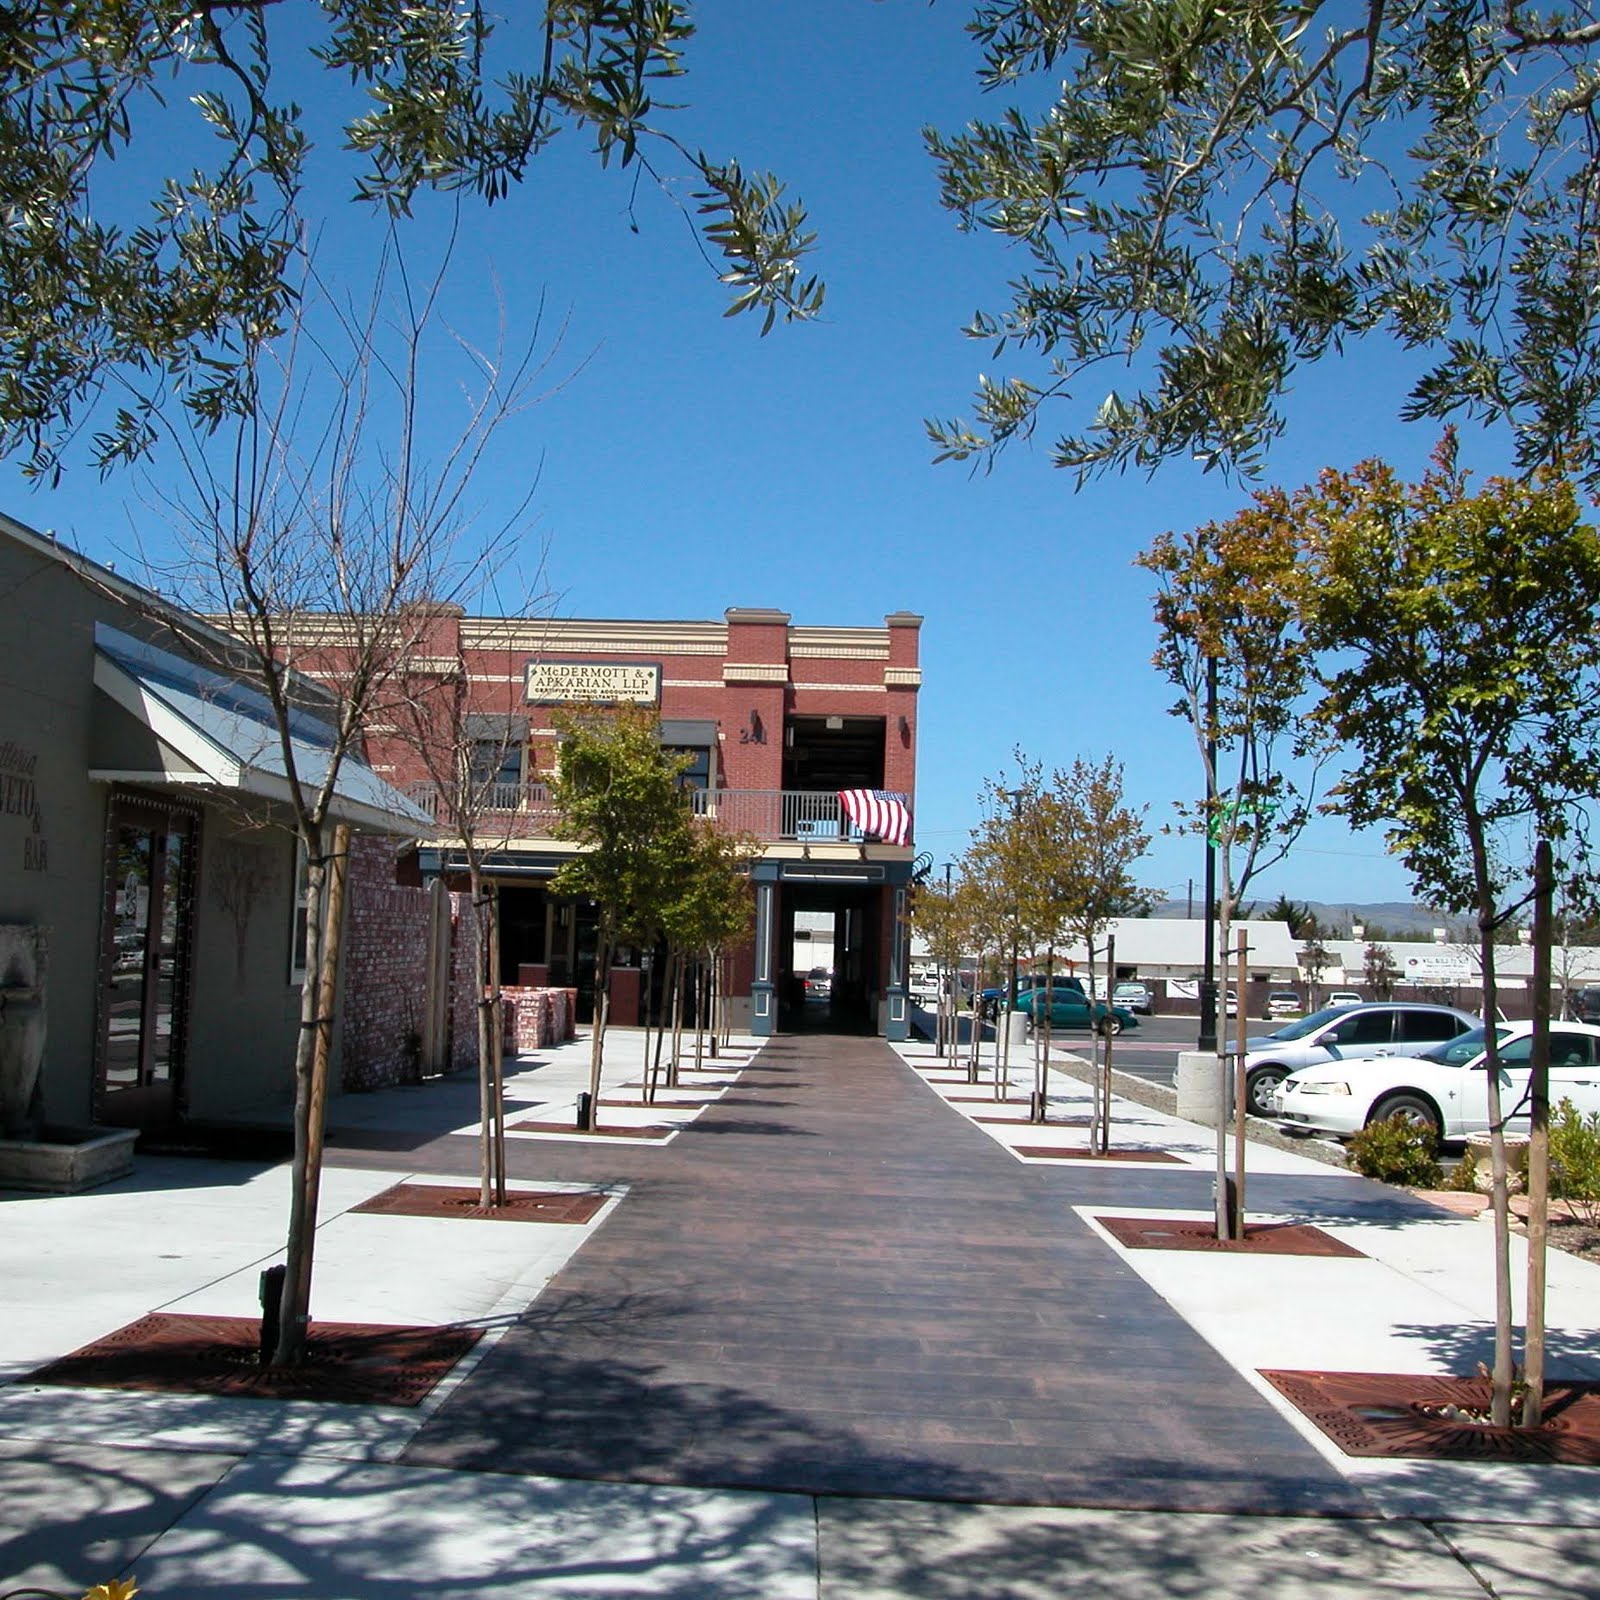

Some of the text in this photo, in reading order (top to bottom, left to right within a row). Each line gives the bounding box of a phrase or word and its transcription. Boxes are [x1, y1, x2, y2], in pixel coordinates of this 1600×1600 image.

[540, 666, 644, 678] McDERMOTT &
[536, 676, 649, 689] APKARIAN, LLP
[24, 837, 48, 872] BAR
